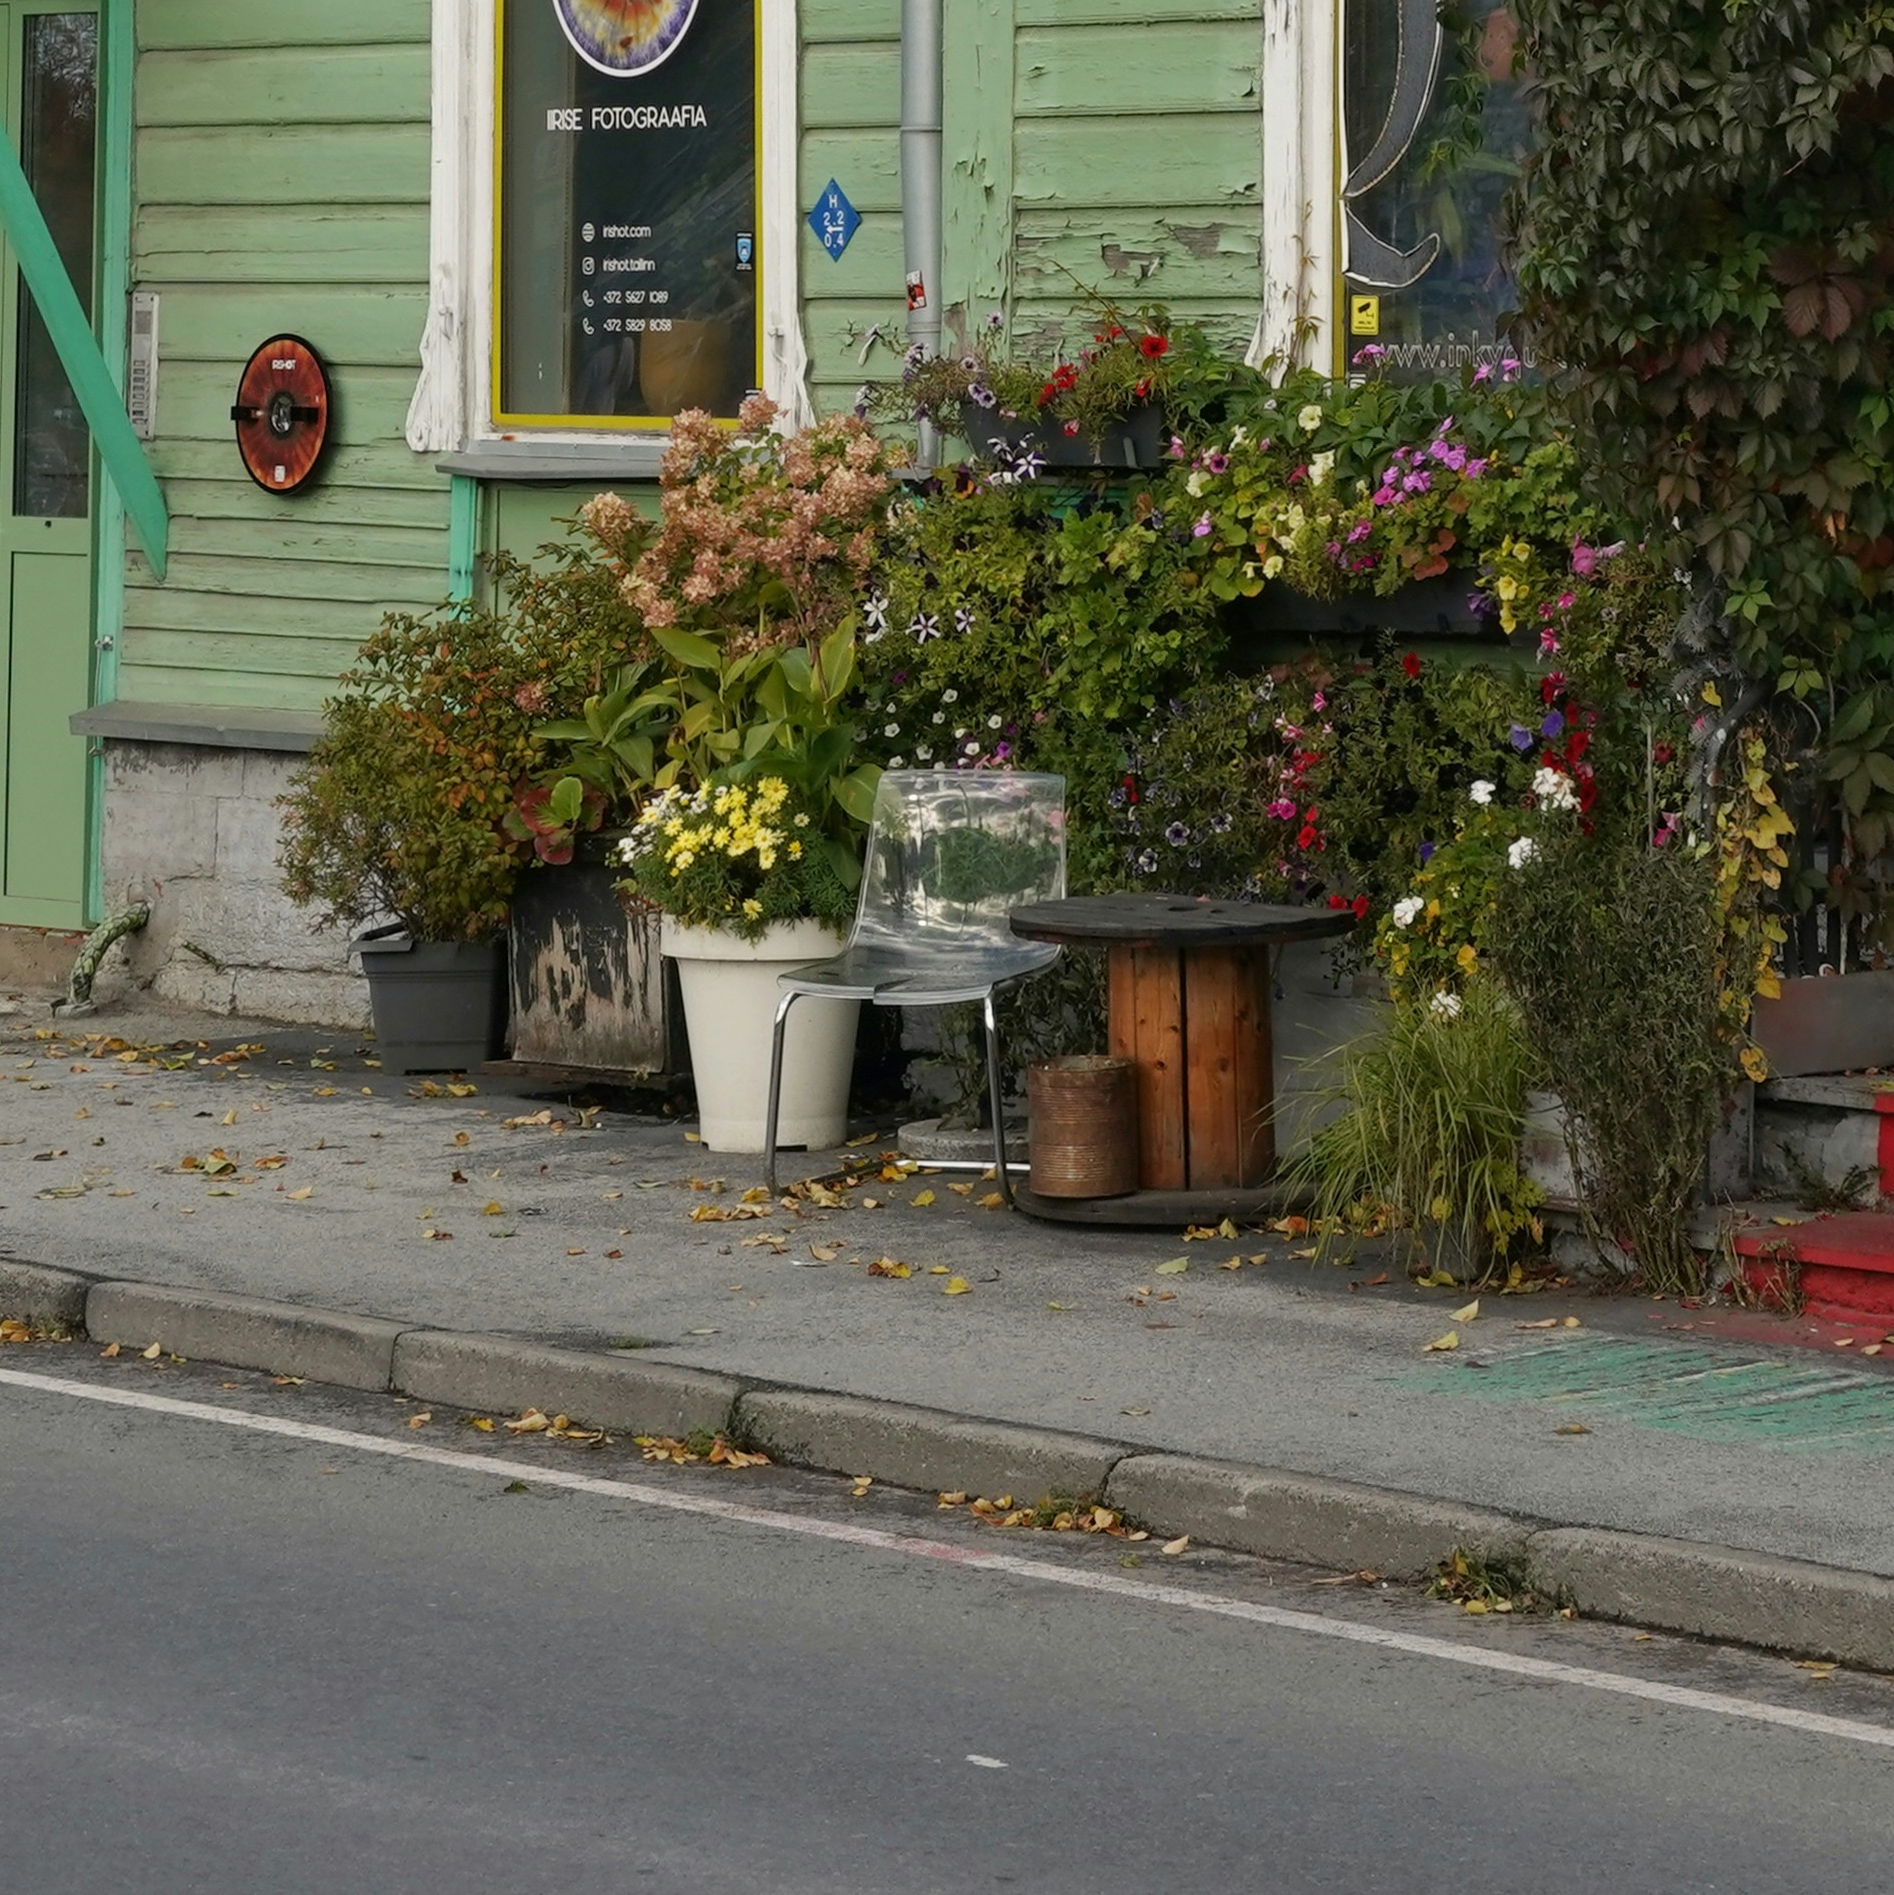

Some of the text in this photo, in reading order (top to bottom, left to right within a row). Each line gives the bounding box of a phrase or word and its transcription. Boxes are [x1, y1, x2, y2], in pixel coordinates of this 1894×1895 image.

[591, 105, 707, 130] FOTOGRAAFIA
[829, 194, 838, 208] H
[823, 210, 845, 226] 2.2
[823, 234, 845, 249] 0.4
